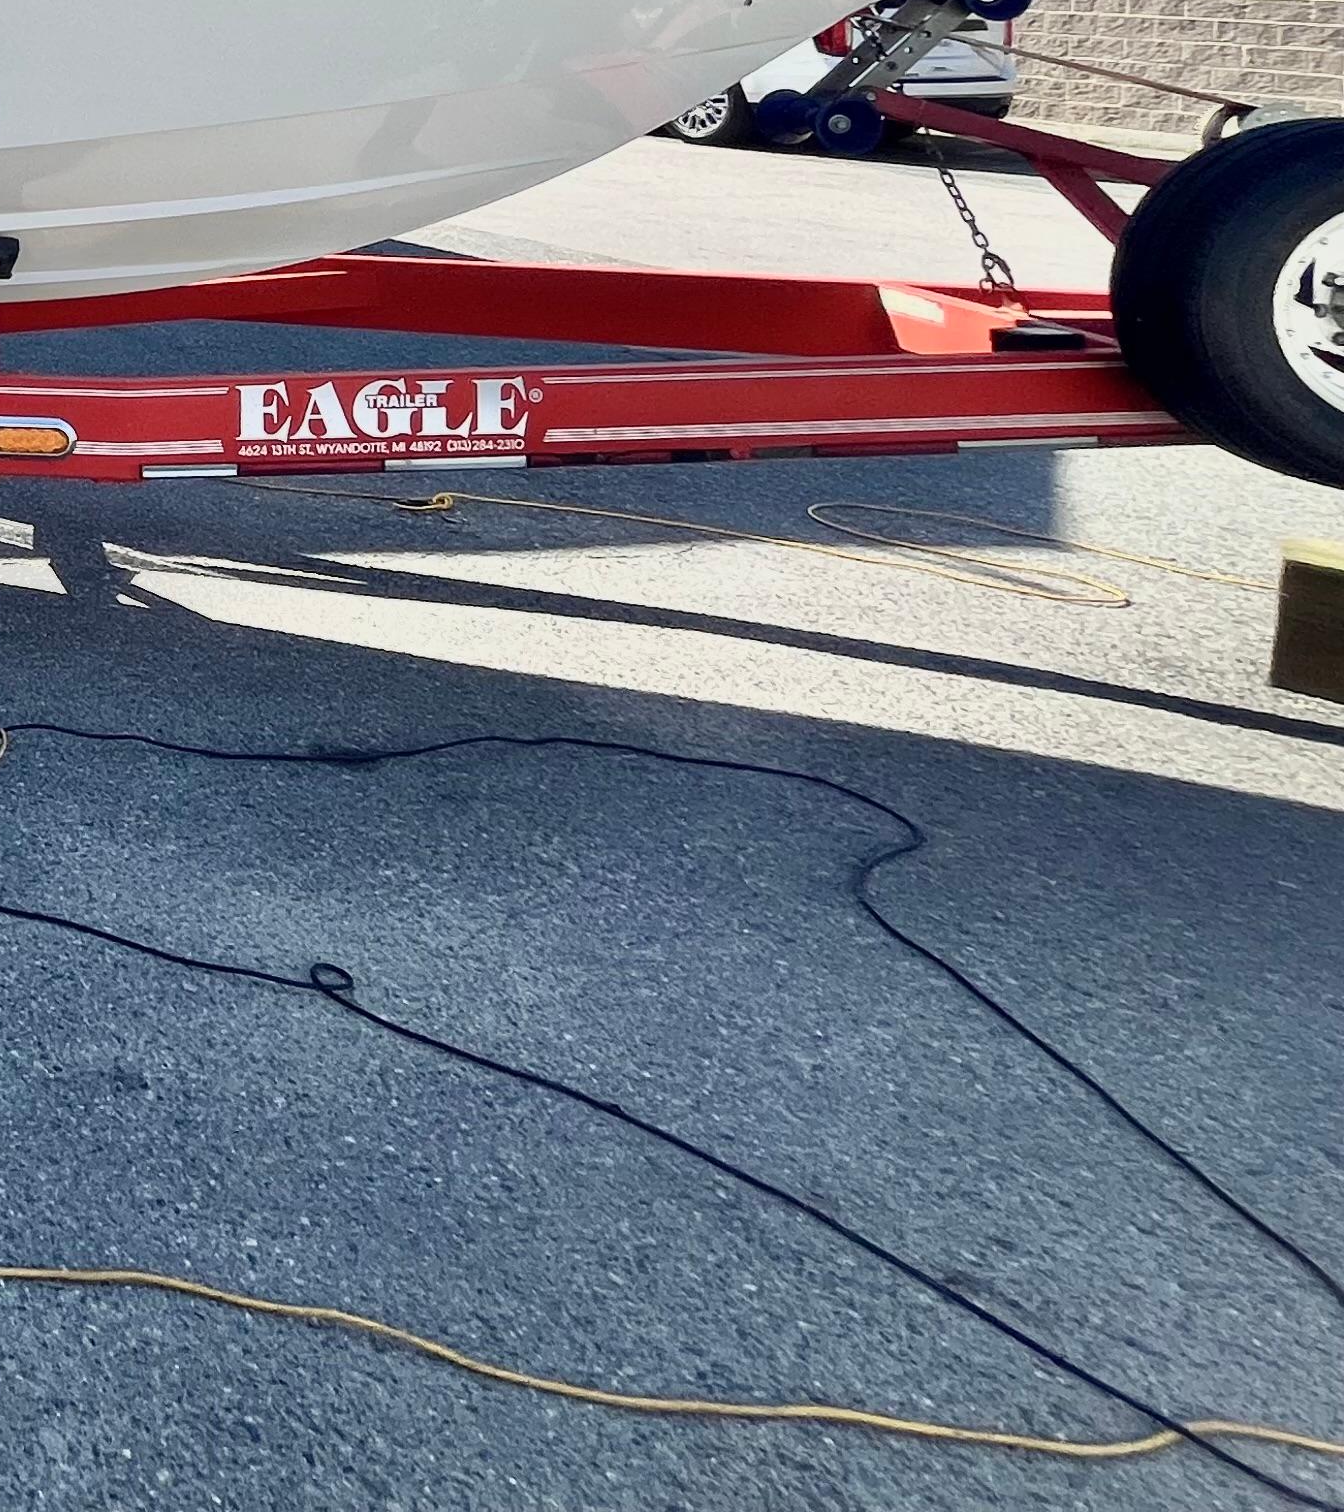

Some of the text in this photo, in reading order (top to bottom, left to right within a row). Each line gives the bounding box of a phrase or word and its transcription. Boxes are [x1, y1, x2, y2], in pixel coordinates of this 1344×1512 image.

[365, 394, 438, 409] TRAILER
[238, 444, 268, 456] 4624
[391, 441, 407, 453] MI
